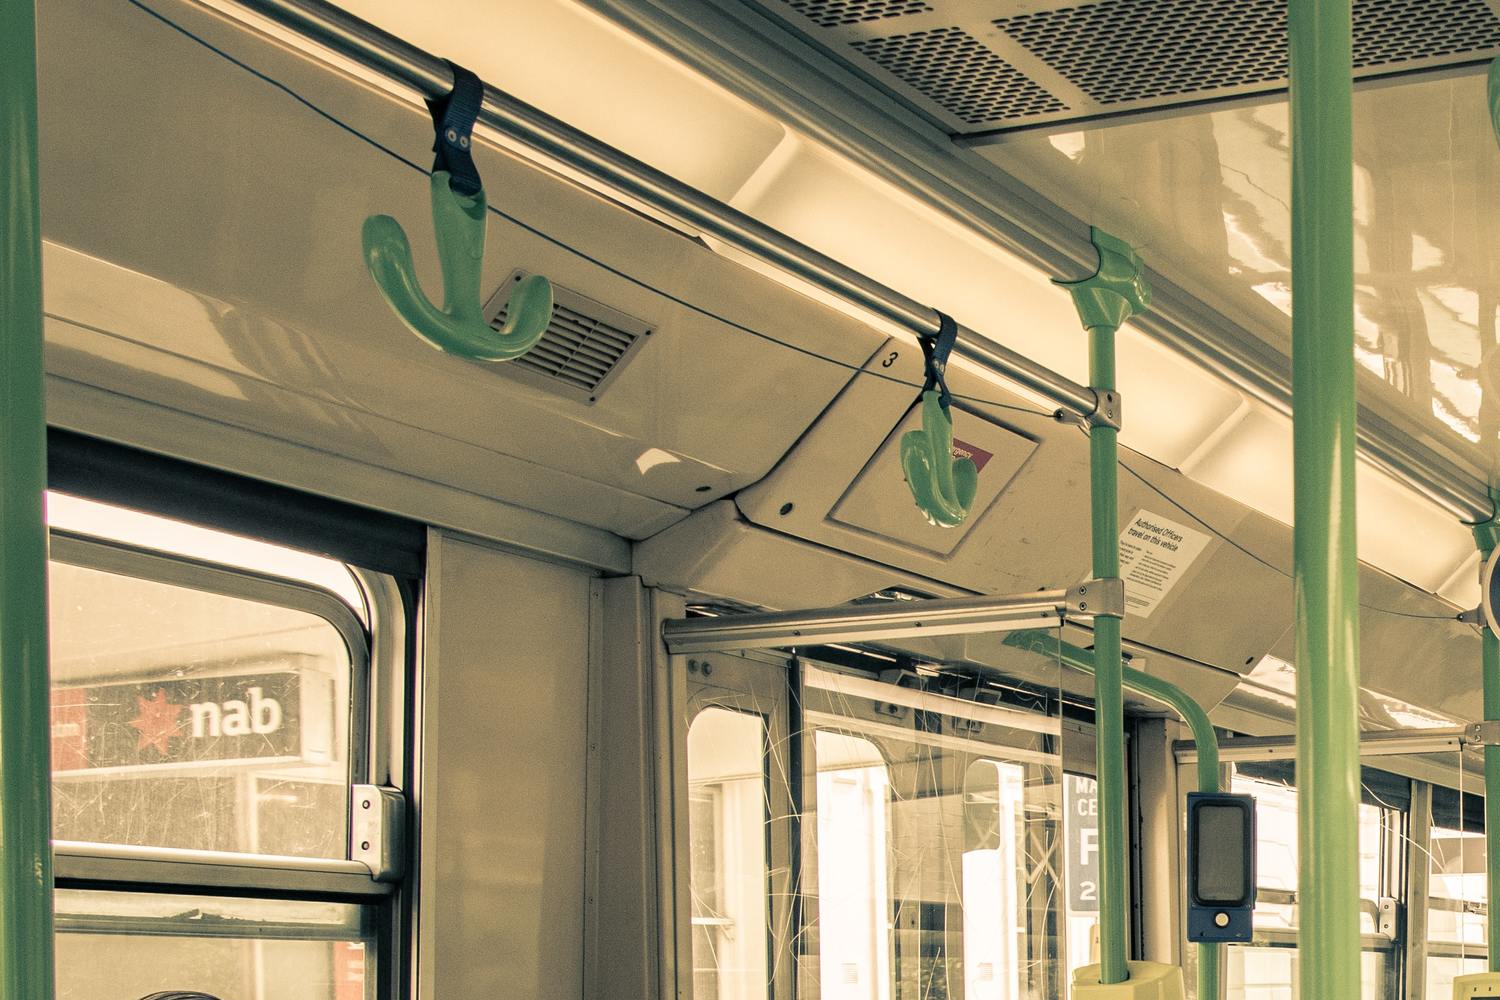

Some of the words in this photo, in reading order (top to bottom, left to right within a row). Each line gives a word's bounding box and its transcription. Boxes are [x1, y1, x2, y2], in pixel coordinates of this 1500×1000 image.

[882, 352, 898, 368] 3
[1128, 528, 1145, 539] travel
[1150, 535, 1161, 545] this
[1160, 541, 1179, 552] vehicle
[1135, 518, 1162, 535] Authorised
[1162, 528, 1183, 542] Officers
[190, 686, 283, 738] nab
